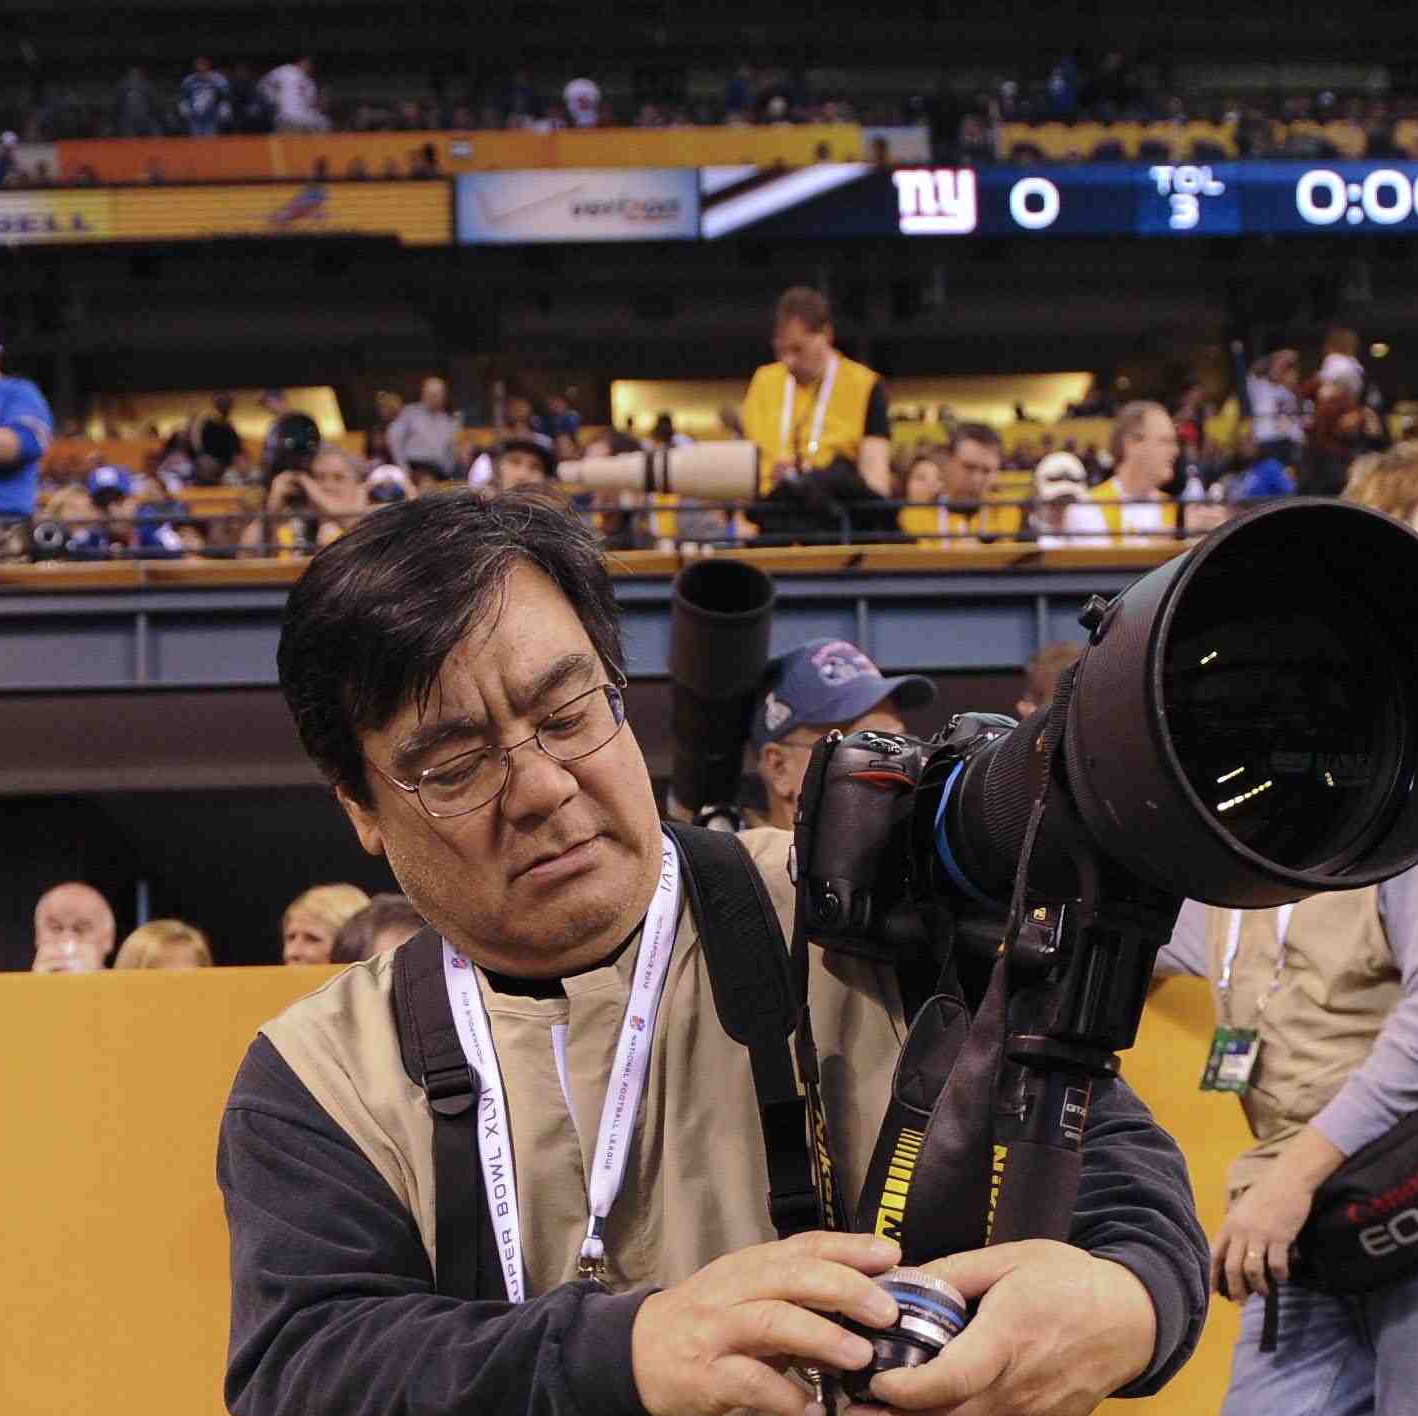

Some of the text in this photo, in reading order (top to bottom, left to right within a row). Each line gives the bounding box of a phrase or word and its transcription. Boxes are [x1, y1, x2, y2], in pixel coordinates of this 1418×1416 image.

[1009, 177, 1060, 229] 0
[1148, 165, 1225, 196] TOL
[1167, 194, 1200, 230] 3
[479, 1086, 500, 1139] XLVI
[612, 1082, 629, 1129] FOOTBALL
[487, 1146, 510, 1218] BOWL
